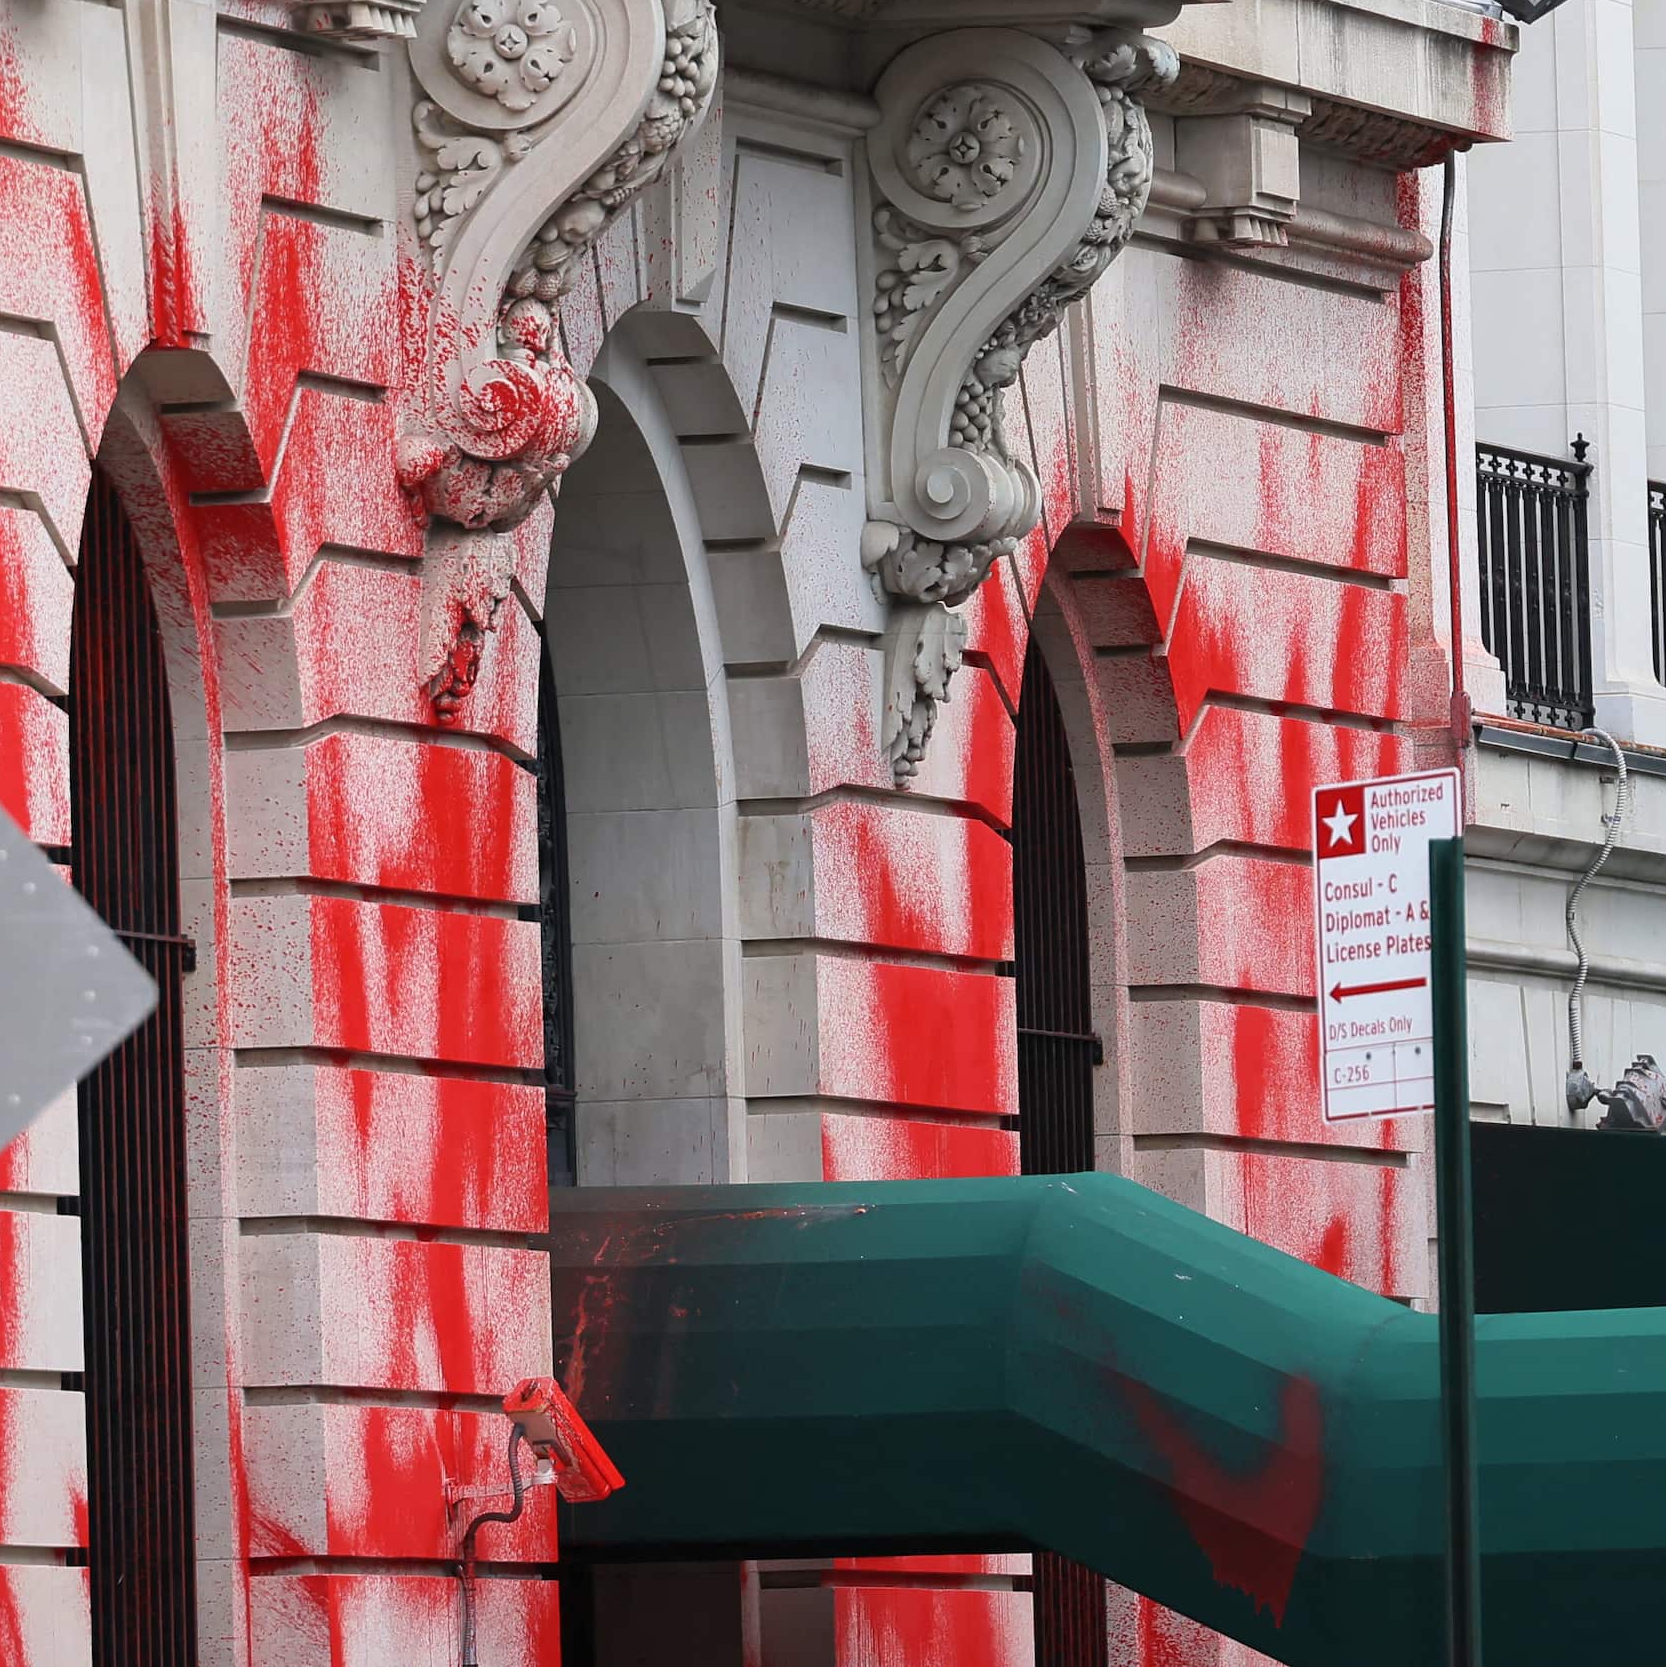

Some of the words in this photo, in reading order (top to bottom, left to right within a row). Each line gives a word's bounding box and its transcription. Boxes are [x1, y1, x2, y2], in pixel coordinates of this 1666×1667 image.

[1371, 782, 1443, 809] Authorized
[1370, 810, 1426, 831] Vehicles
[1371, 833, 1401, 854] Only
[1324, 877, 1373, 902] Consul
[1388, 873, 1398, 894] C
[1325, 905, 1391, 935] Diplomat
[1406, 901, 1415, 922] A
[1420, 900, 1430, 920] &
[1327, 941, 1382, 963] License
[1386, 933, 1432, 957] Plates
[1329, 1022, 1348, 1041] D/S
[1351, 1018, 1386, 1038] Decals
[1389, 1015, 1413, 1034] Only
[1334, 1064, 1370, 1084] C-256
